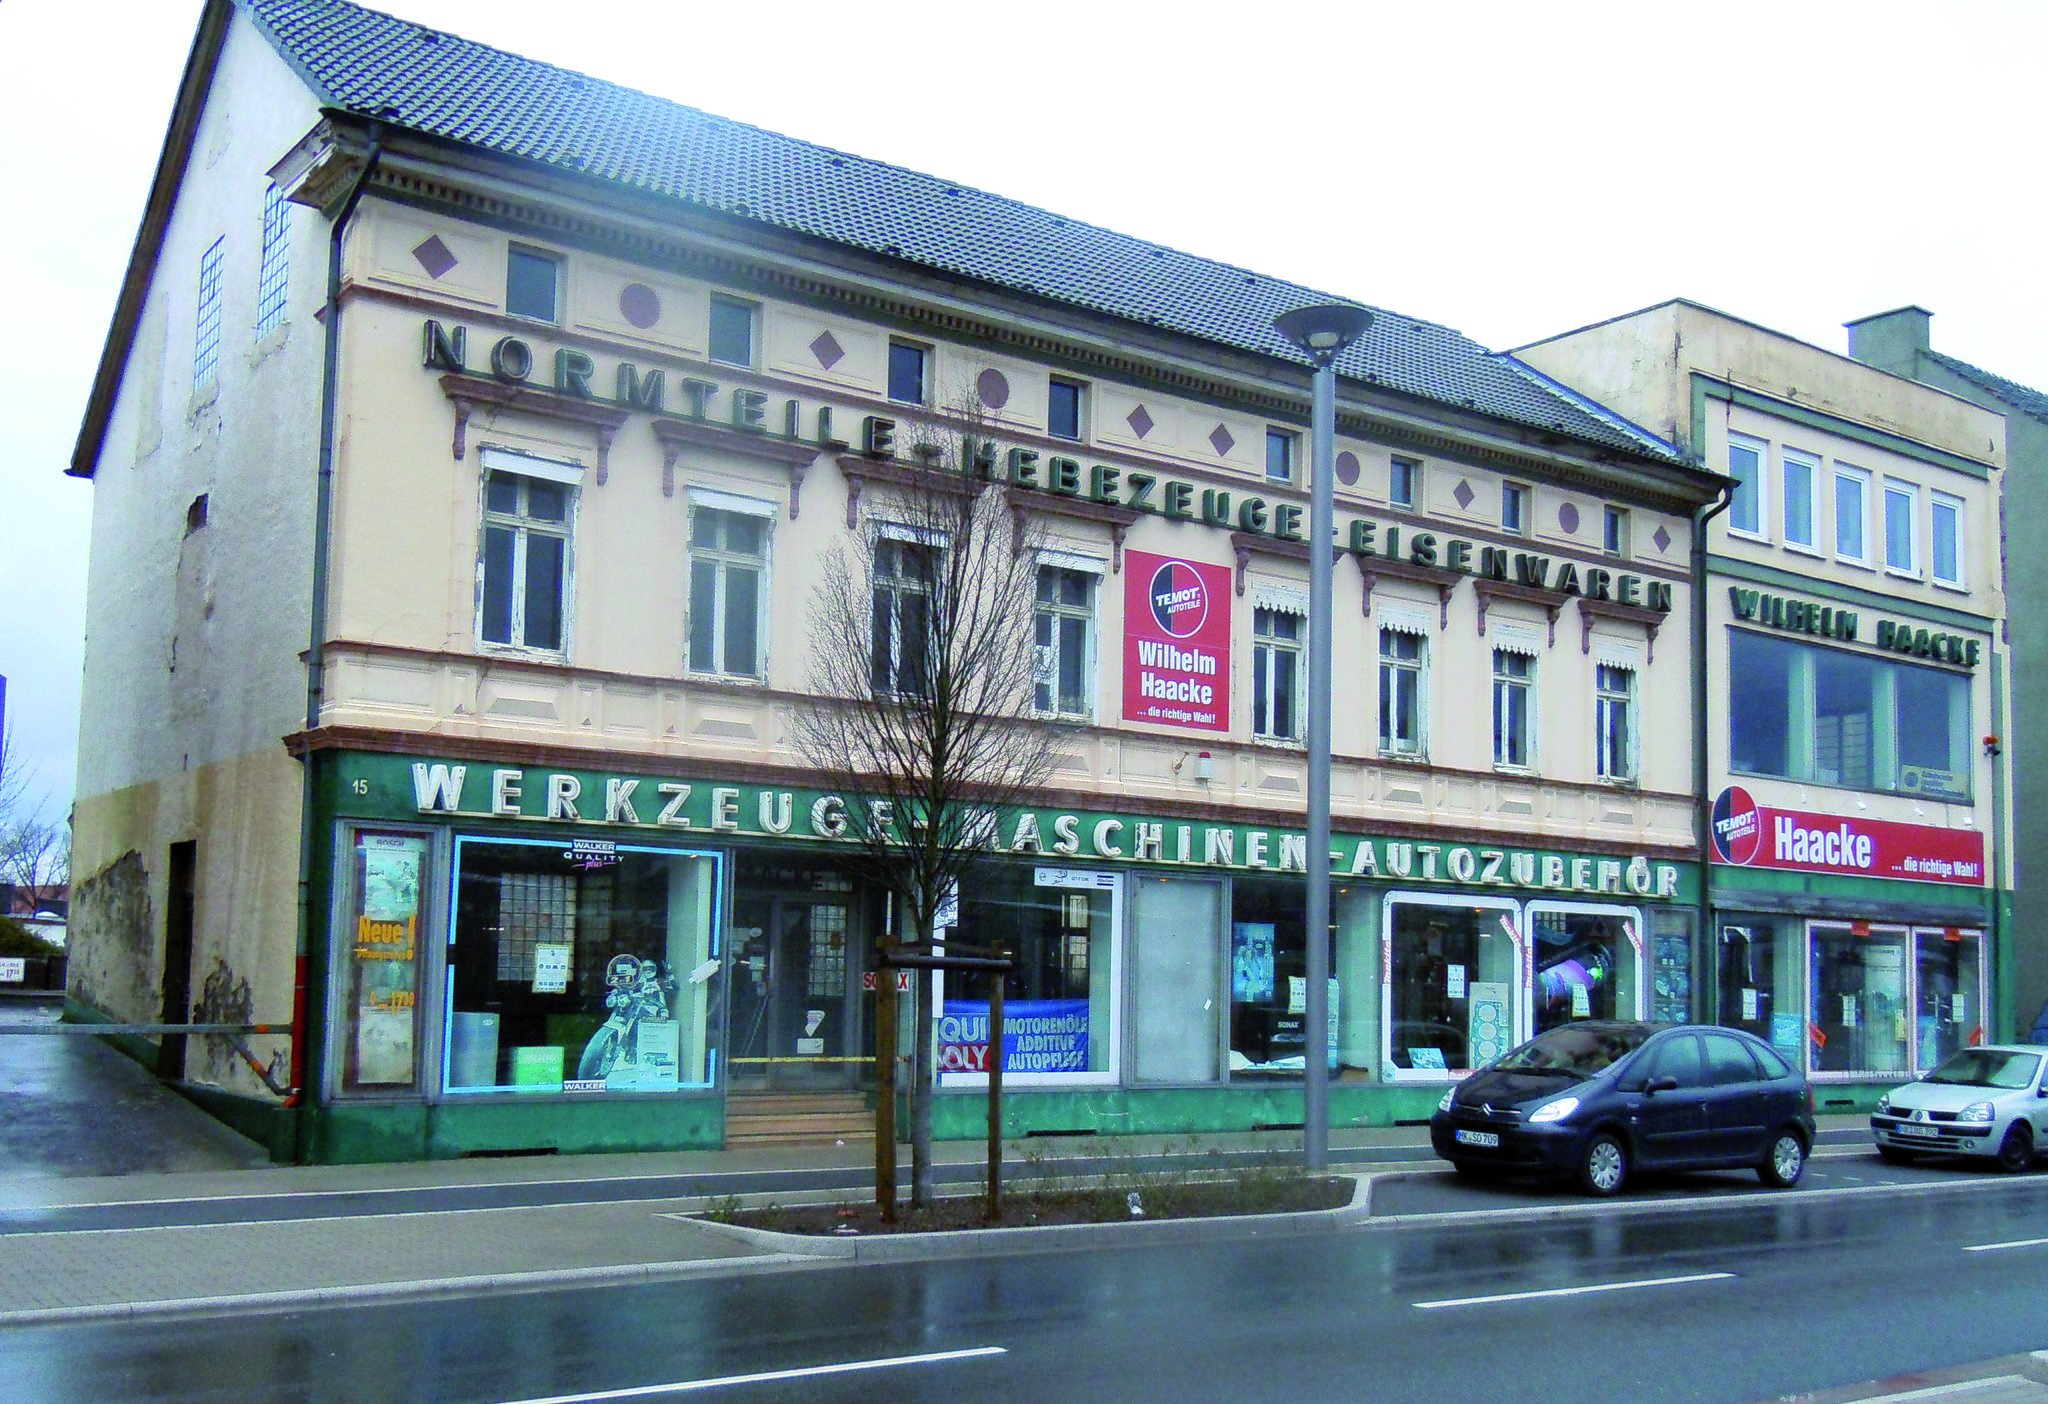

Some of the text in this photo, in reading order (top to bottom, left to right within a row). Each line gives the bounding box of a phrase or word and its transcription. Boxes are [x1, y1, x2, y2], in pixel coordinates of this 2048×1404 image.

[1155, 587, 1200, 607] TEMOT
[1166, 599, 1201, 615] AUTOTEILE
[1728, 586, 1981, 667] WILHELM HAACKE
[1138, 640, 1216, 676] Wilhelm
[1141, 671, 1213, 705] Haacke
[1147, 705, 1161, 718] die
[1162, 708, 1192, 723] richtige
[352, 779, 368, 795] 15
[1716, 811, 1756, 834] TEMOT
[1726, 824, 1756, 842] AUTOTEILE
[1774, 816, 1871, 869] Haacke
[563, 851, 624, 862] QUALITY
[573, 842, 615, 851] WALKER
[1903, 856, 1918, 872] die
[1919, 857, 1952, 878] richtige
[358, 915, 403, 944] Neue
[564, 1083, 606, 1091] WALKER
